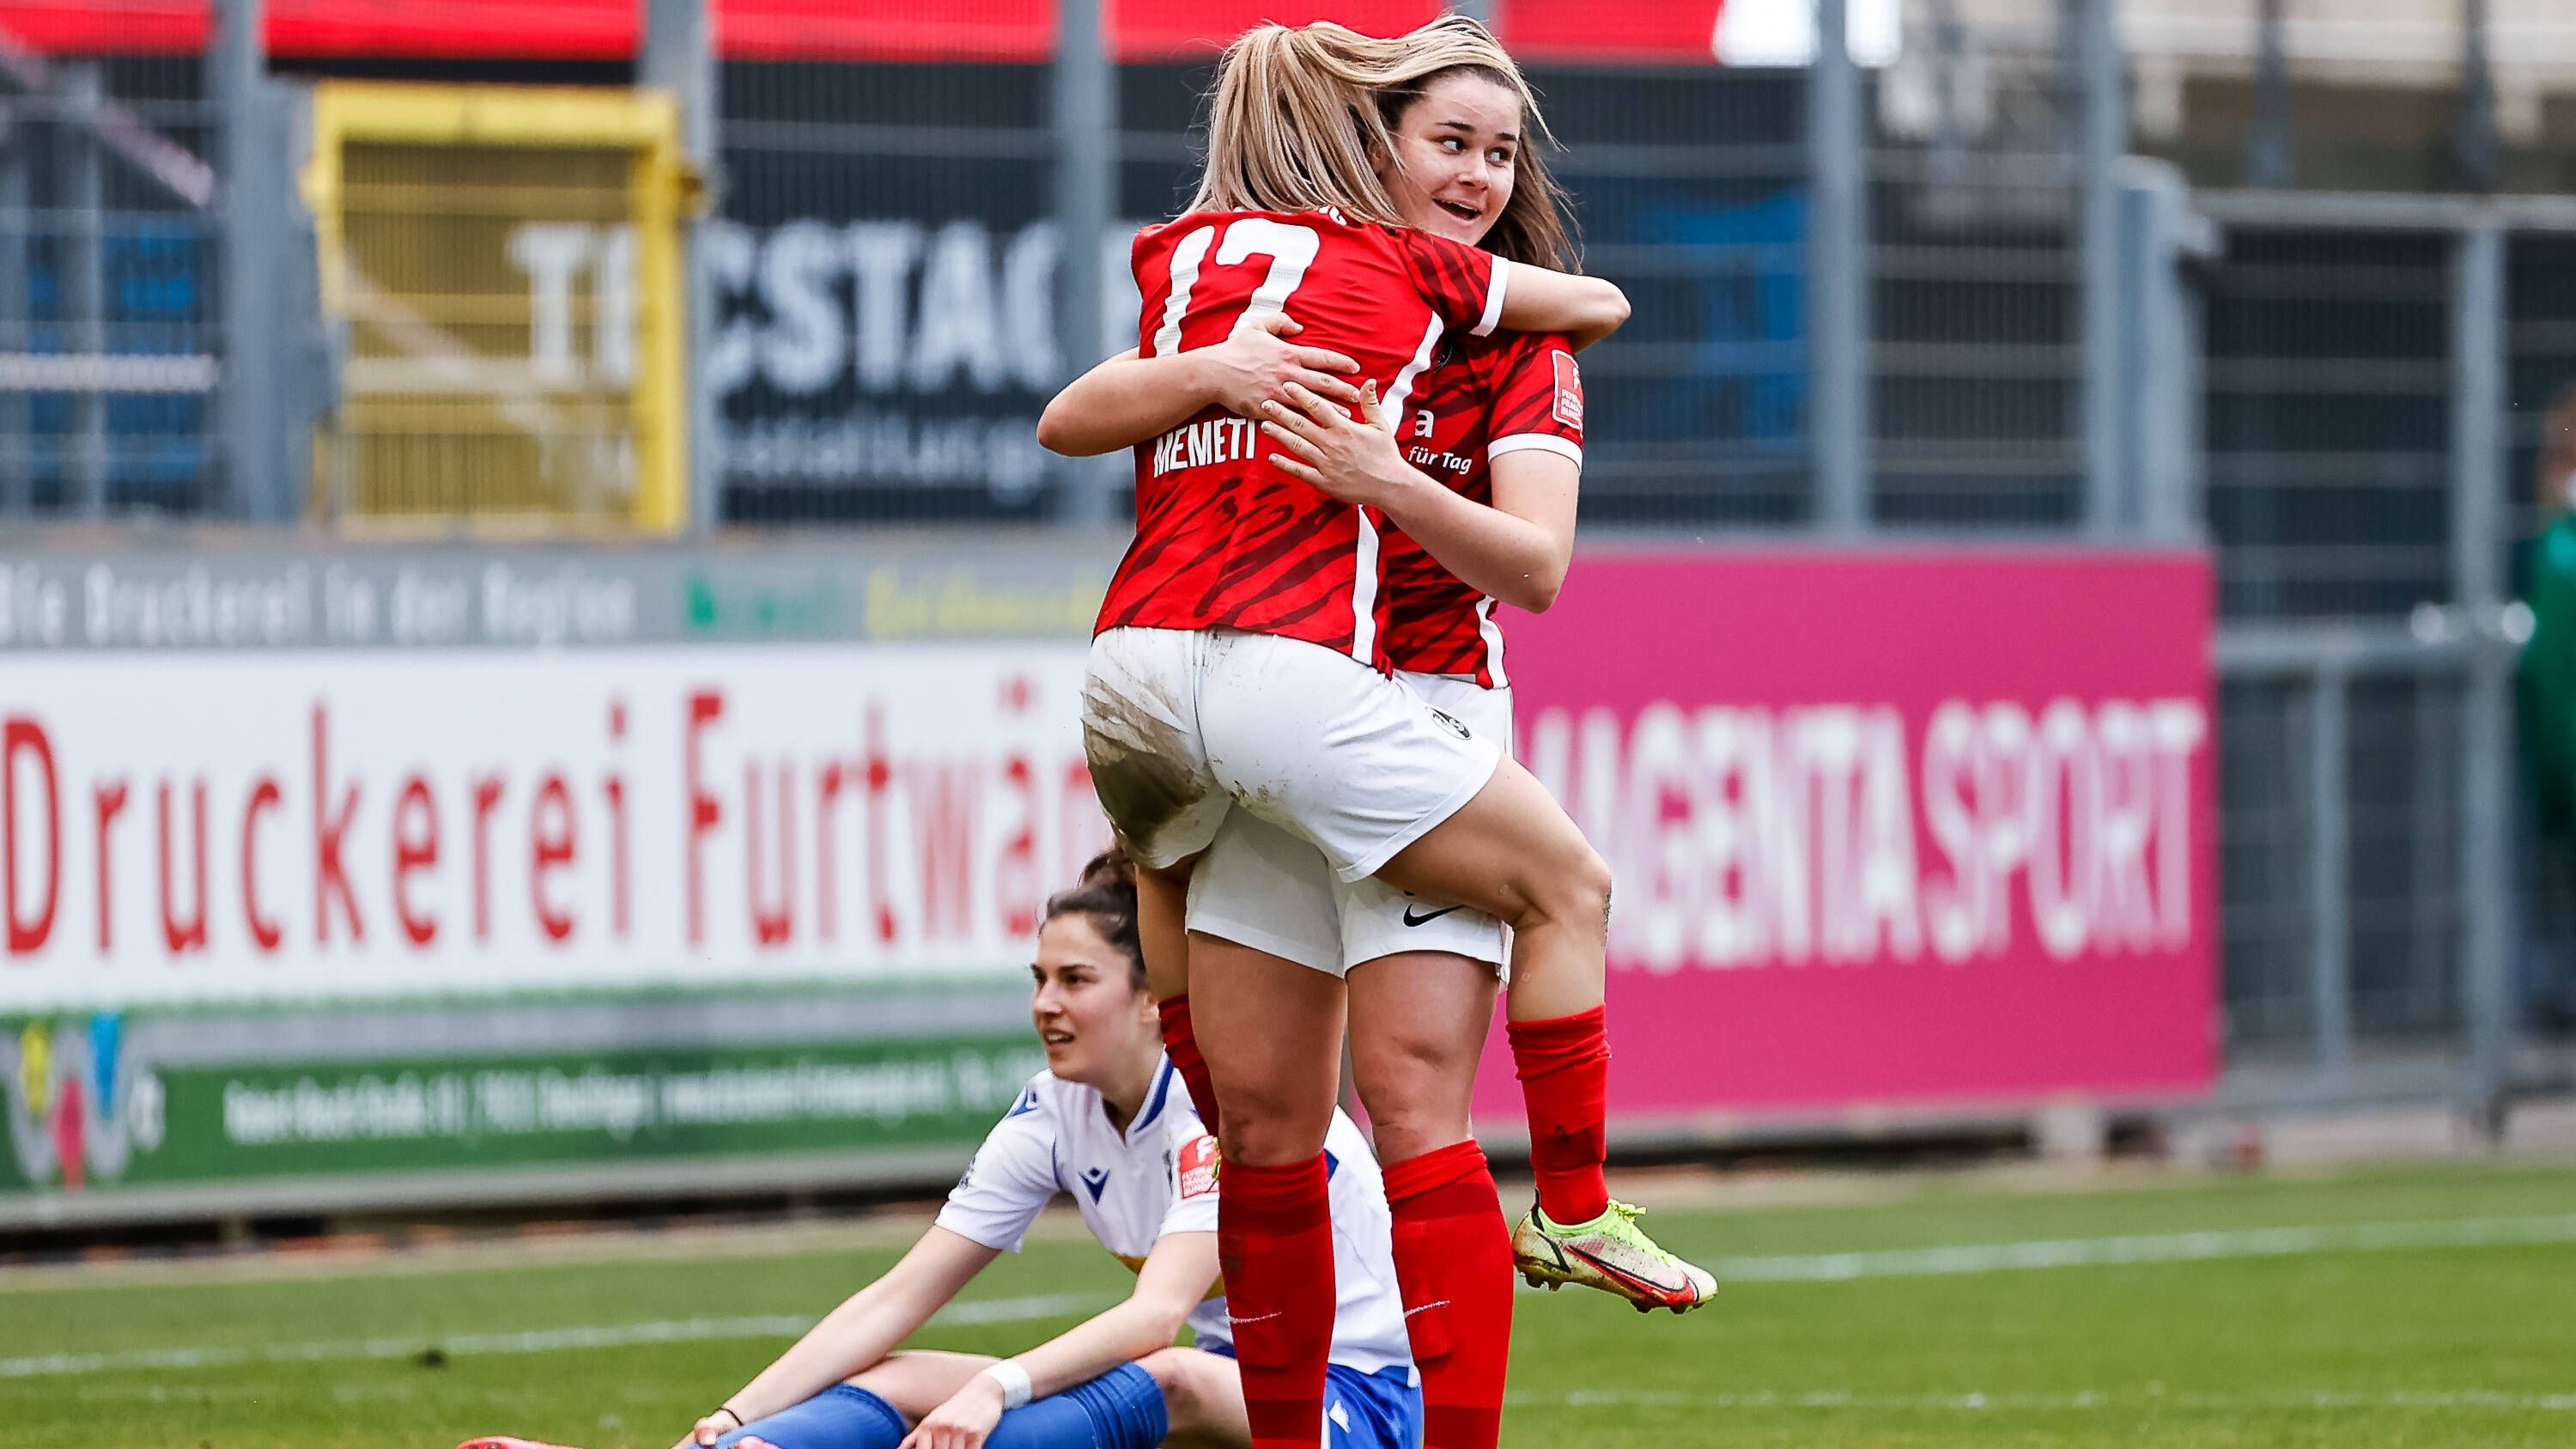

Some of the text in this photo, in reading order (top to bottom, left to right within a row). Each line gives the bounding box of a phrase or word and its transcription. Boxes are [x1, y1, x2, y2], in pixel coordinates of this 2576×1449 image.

[1154, 217, 1321, 356] 17
[1153, 417, 1255, 478] MEMETI
[1408, 446, 1473, 475] für Tag
[3, 694, 629, 956] Druckerei
[1514, 698, 2206, 977] AGENTA SPORT
